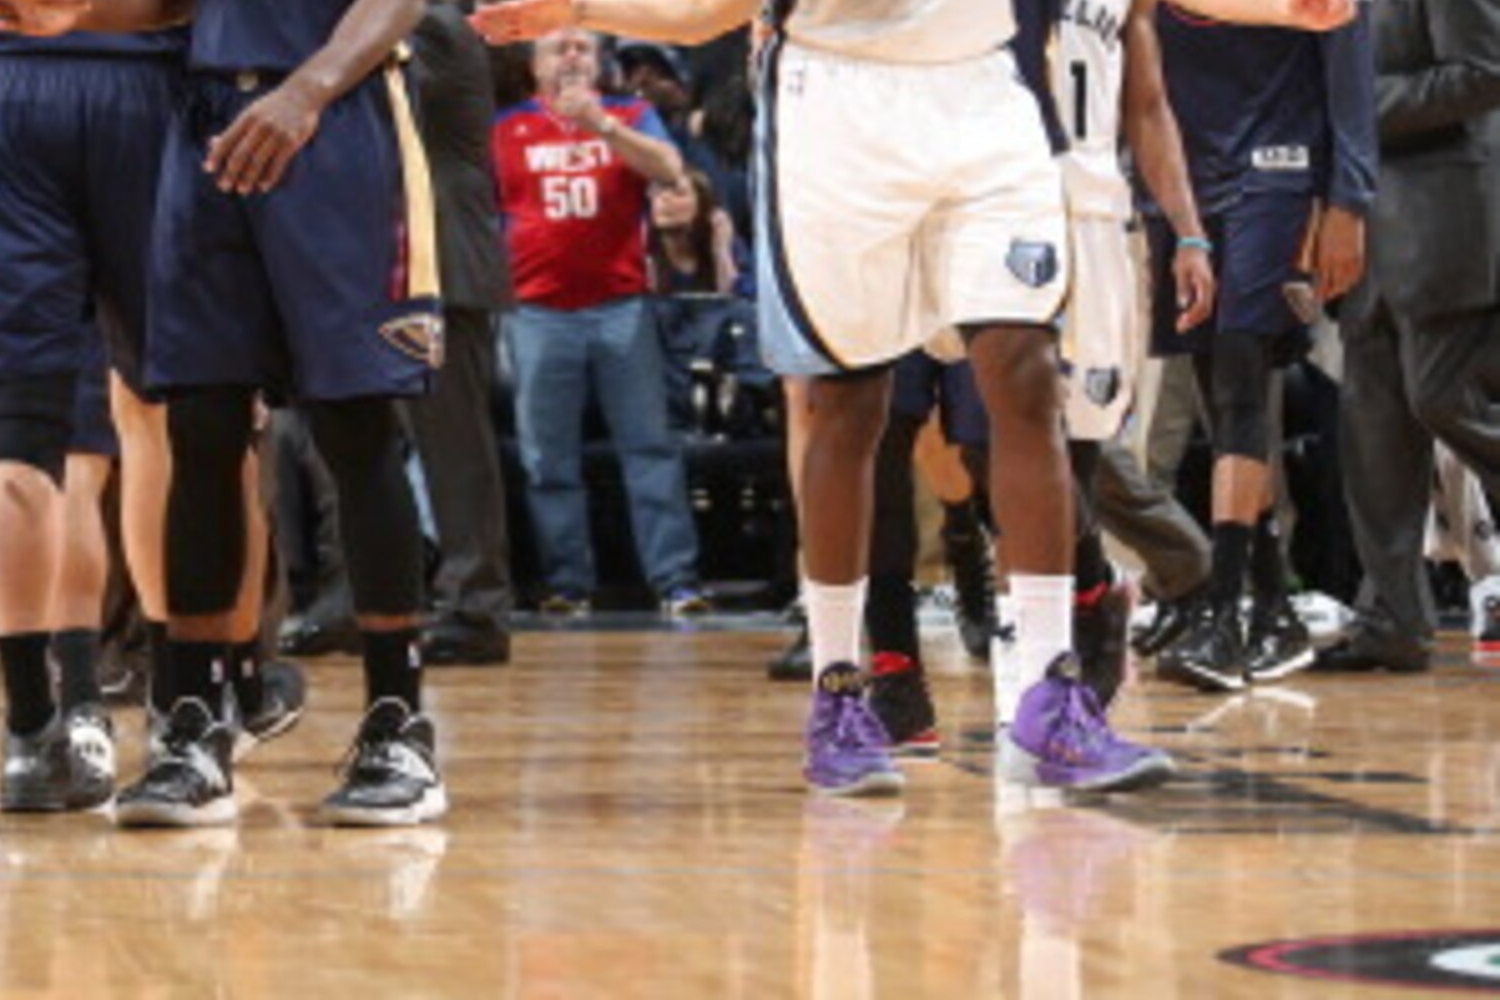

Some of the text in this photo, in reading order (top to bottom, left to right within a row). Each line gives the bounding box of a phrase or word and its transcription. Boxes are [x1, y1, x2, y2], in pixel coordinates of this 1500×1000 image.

[1069, 60, 1088, 141] 1
[525, 139, 613, 173] WEST
[541, 175, 598, 220] 50
